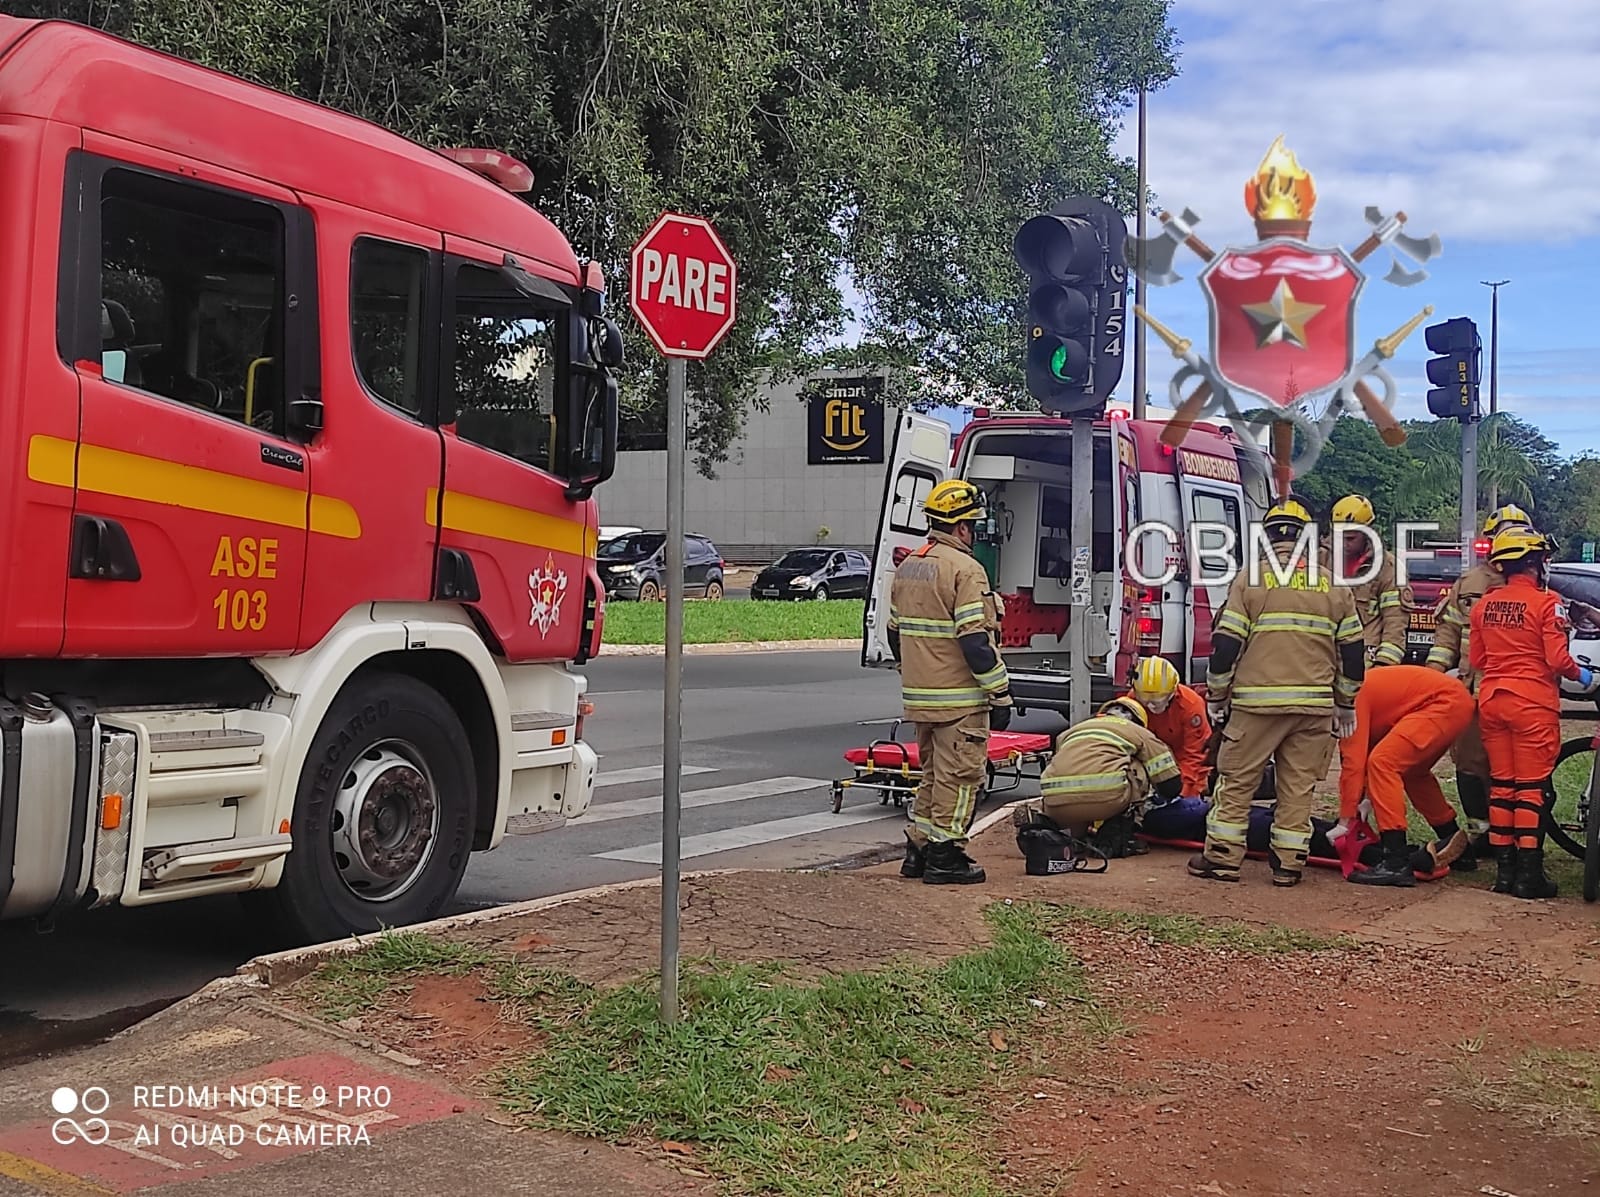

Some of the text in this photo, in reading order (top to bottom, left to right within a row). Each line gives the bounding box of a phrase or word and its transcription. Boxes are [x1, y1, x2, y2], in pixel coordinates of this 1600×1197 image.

[640, 248, 728, 316] PARE
[1104, 291, 1123, 357] 154
[825, 385, 867, 398] smart
[825, 399, 866, 437] fit
[1182, 451, 1238, 482] BOMBEIROS
[210, 536, 278, 578] ASE
[213, 588, 267, 630] 103
[1483, 612, 1525, 624] MILITAR
[1484, 601, 1527, 615] BOMBEIRO
